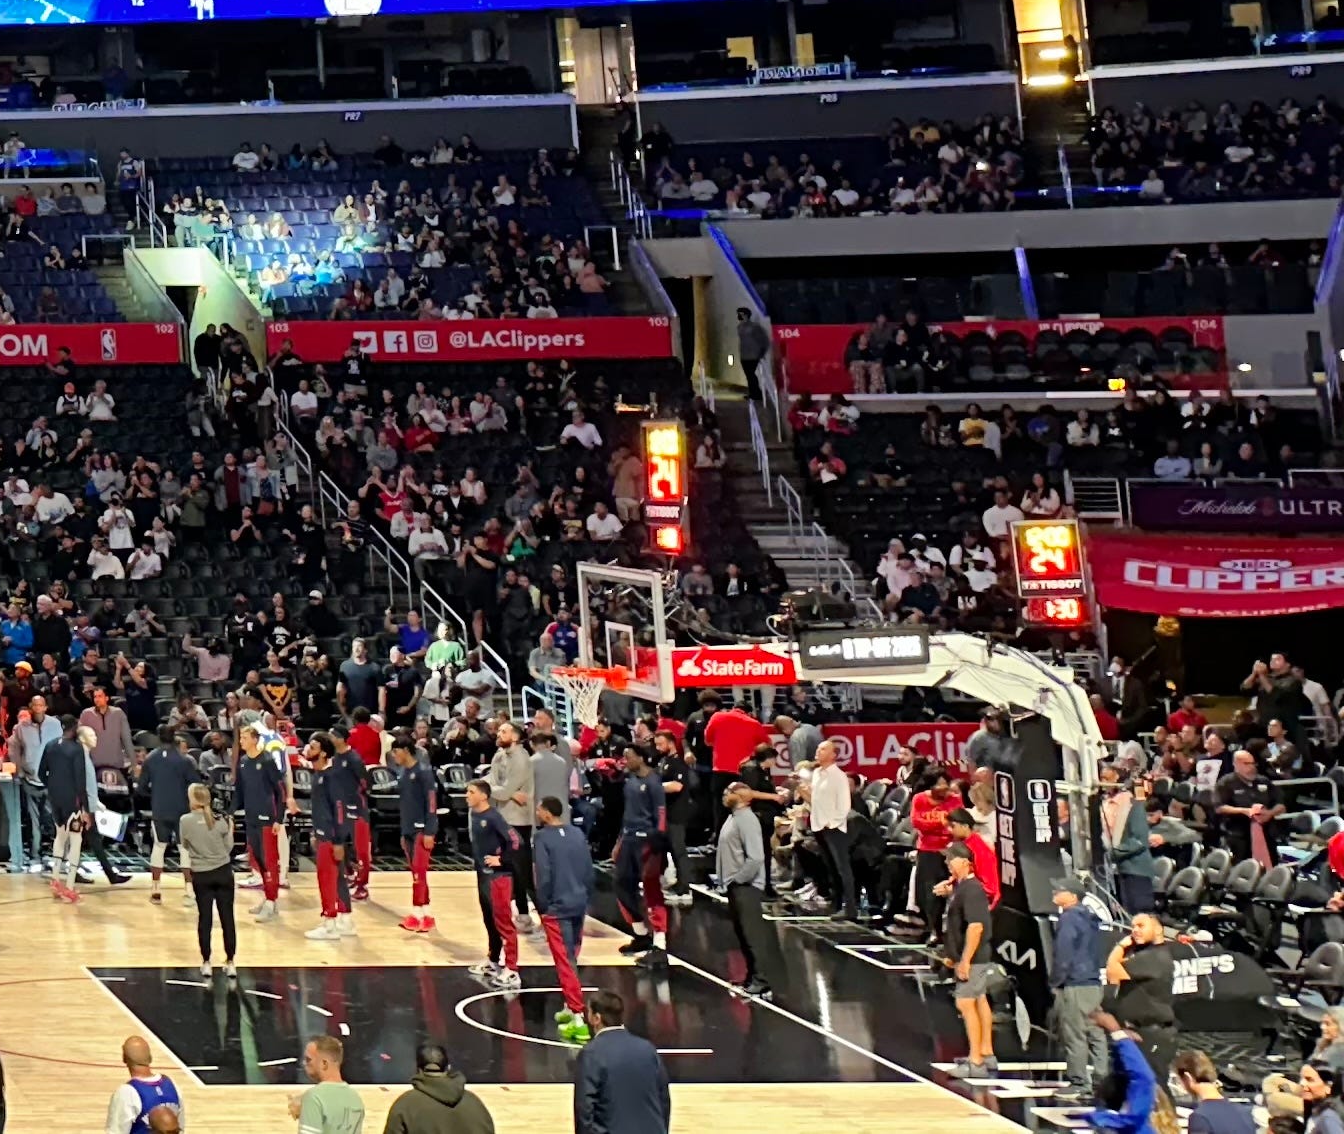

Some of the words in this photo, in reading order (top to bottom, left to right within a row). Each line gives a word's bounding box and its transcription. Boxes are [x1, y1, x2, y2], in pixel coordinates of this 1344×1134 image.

[648, 316, 668, 327] 103
[1192, 319, 1216, 331] 104
[154, 324, 174, 334] 102
[269, 323, 289, 333] 103
[778, 327, 800, 338] 104
[448, 329, 584, 352] @LAClippers
